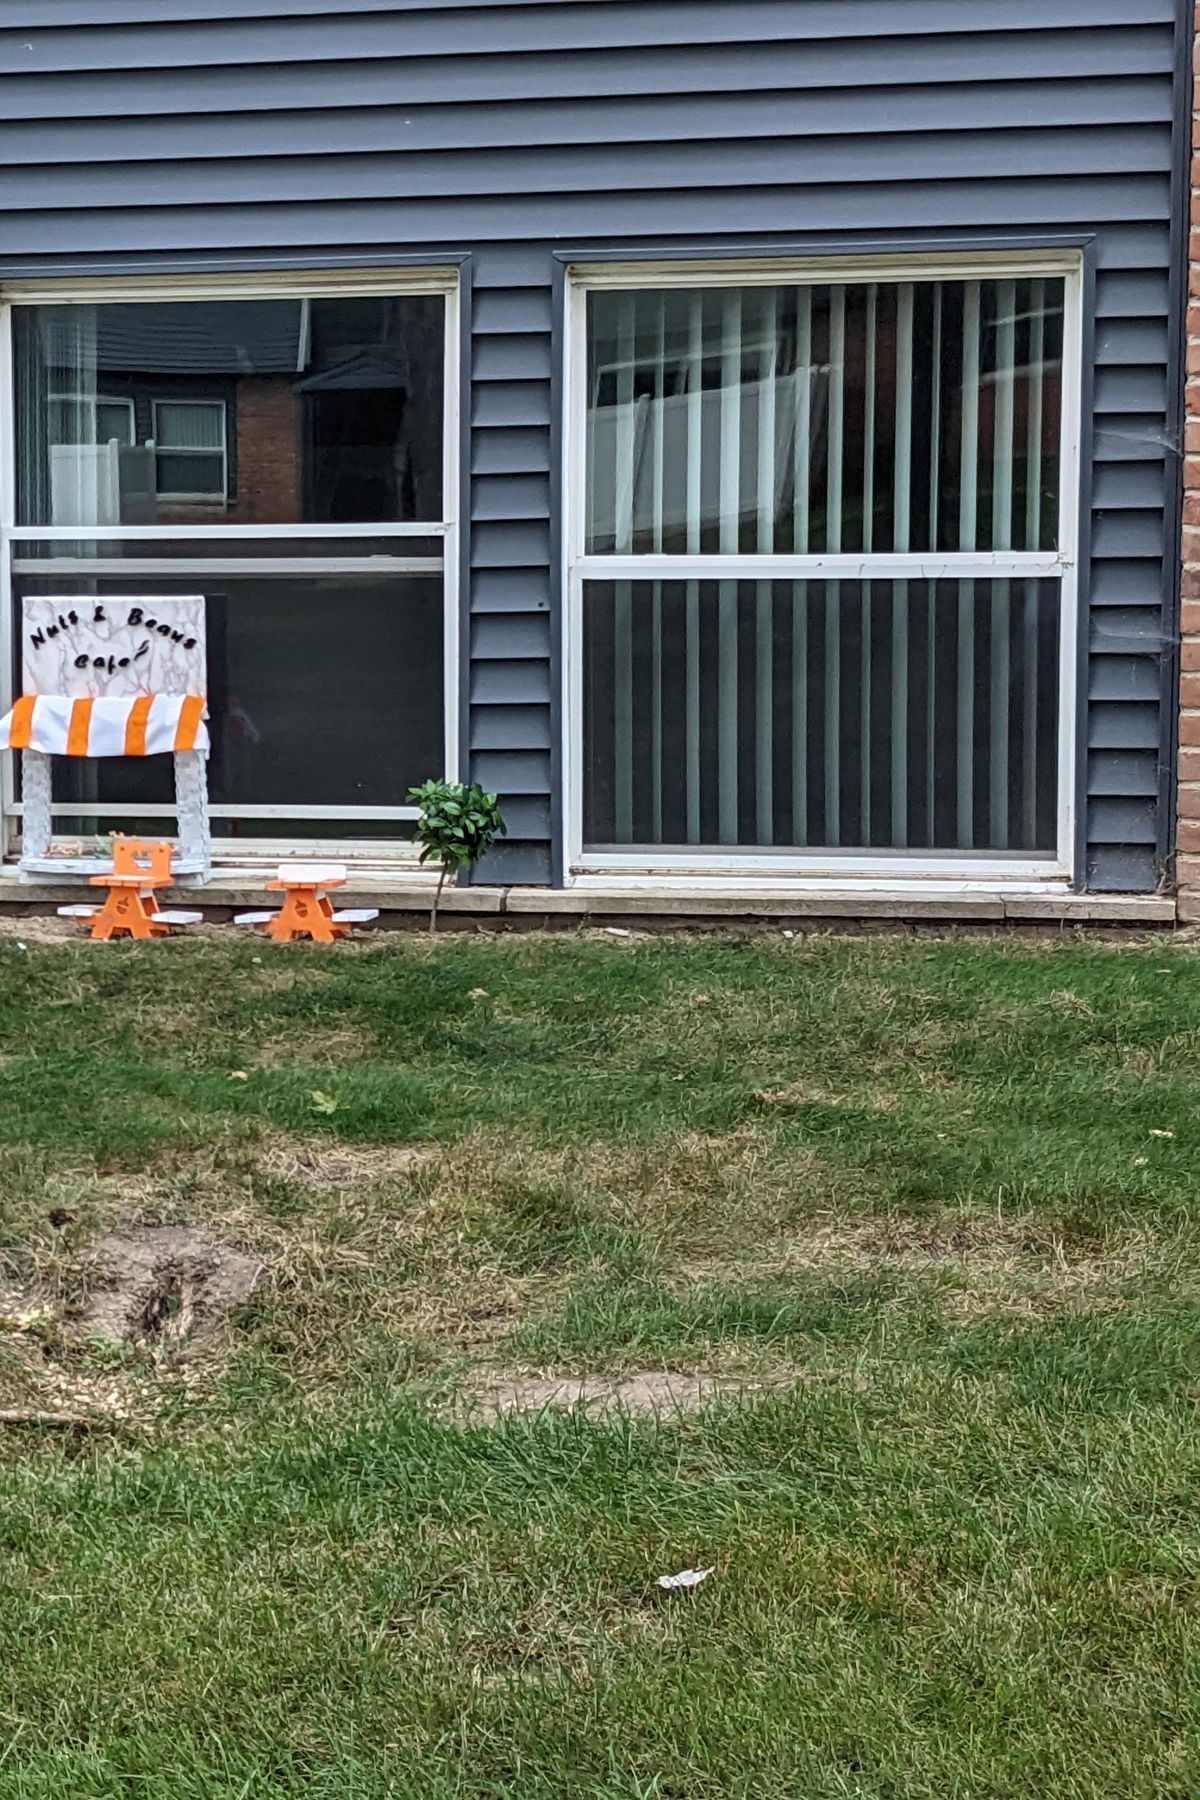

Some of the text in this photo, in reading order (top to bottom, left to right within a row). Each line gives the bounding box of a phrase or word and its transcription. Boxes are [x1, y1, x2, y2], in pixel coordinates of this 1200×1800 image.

[30, 605, 197, 650] Nuts & Beans
